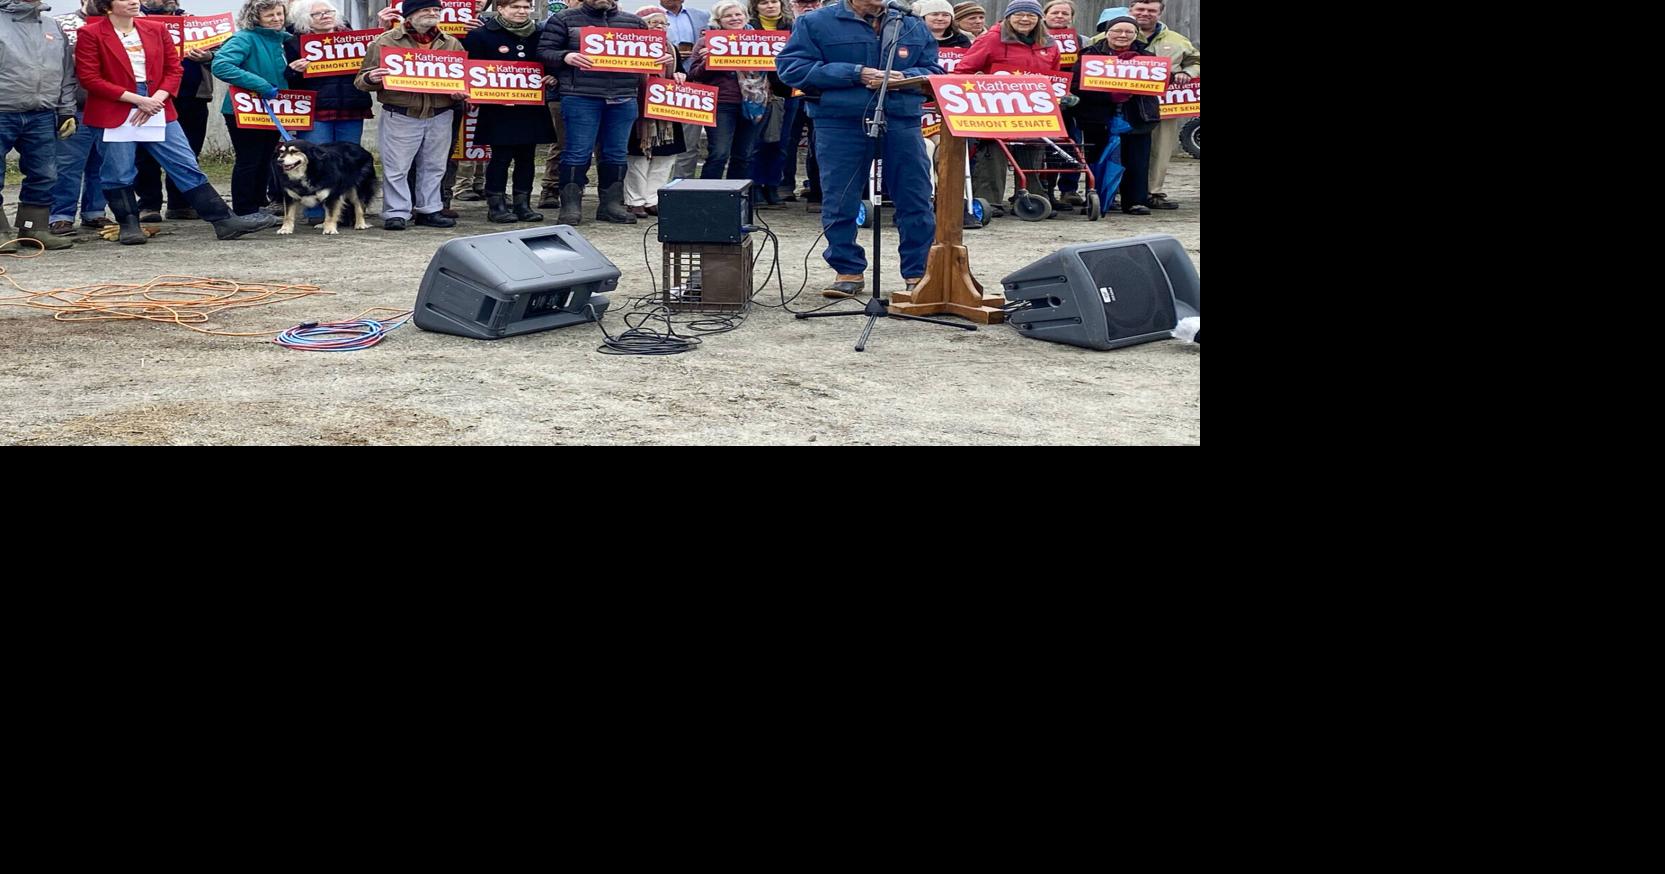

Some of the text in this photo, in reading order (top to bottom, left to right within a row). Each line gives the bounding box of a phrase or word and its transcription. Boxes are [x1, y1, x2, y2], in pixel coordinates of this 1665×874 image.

[184, 22, 232, 41] ms
[616, 32, 663, 42] Katherine
[739, 33, 786, 42] Katherine
[304, 40, 376, 61] Sim
[585, 34, 664, 58] Sims
[709, 36, 786, 56] Sims
[415, 53, 464, 63] Katherine
[592, 58, 628, 66] ERMONT
[1116, 58, 1167, 66] Katherine
[310, 62, 349, 71] VERMONT
[385, 54, 465, 78] Sims
[496, 65, 541, 74] Katherine
[1085, 60, 1167, 81] Sims
[391, 79, 460, 88] VERMONT SENATE
[469, 67, 542, 89] Sims
[1089, 79, 1160, 90] VERMONT SENATE
[675, 84, 715, 97] Katherine
[976, 81, 1047, 91] Katherine
[234, 92, 312, 114] Sims
[648, 84, 715, 111] Sims
[939, 84, 1055, 113] Sims
[652, 107, 709, 120] VERMONT SENATE
[956, 120, 1053, 128] VERMONT SENATE
